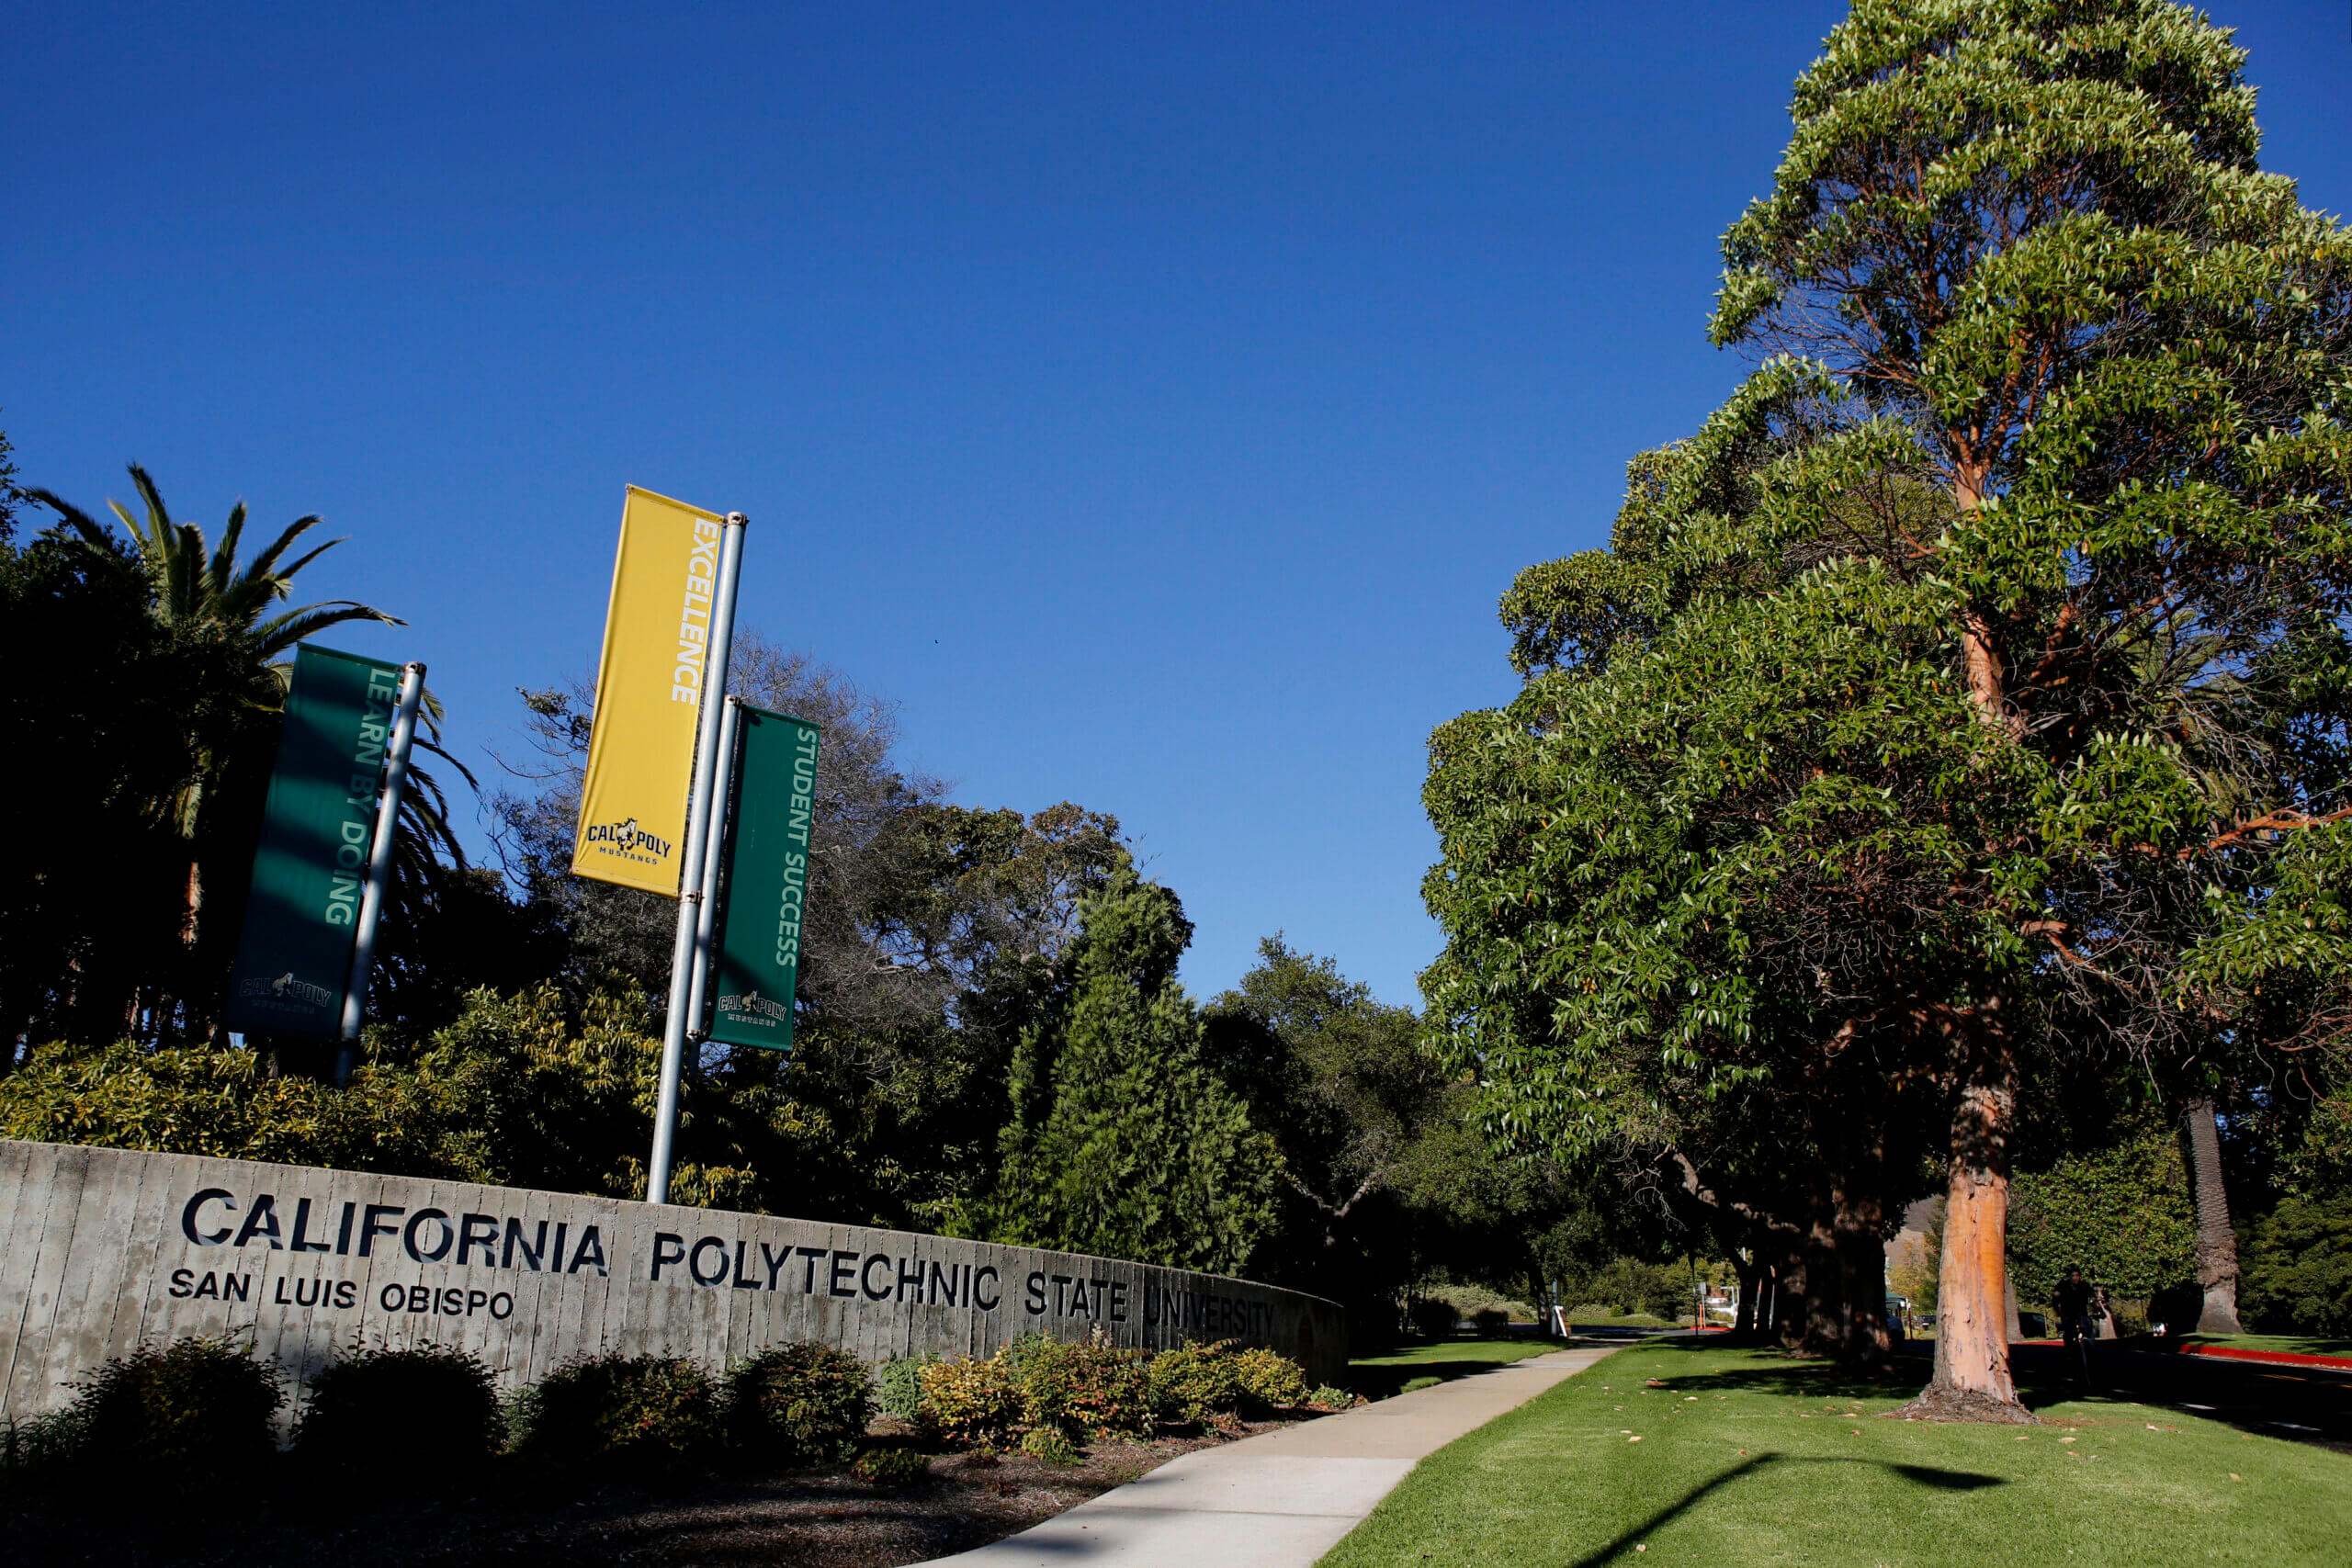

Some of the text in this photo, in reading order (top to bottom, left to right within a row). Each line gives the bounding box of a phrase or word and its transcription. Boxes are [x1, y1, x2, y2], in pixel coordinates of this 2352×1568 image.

[672, 517, 718, 705] EXCELLENCE
[324, 668, 398, 926] LEARN BY DOING
[588, 825, 671, 859] CAL POLY
[775, 727, 817, 967] STUDENT SUCCESS
[599, 846, 658, 865] MUSTANGS
[718, 995, 786, 1021] CAL POLY
[169, 1269, 514, 1321] SAN LUIS OBISPO
[182, 1188, 1274, 1338] CALIFORNIA POLYTECHNIC STATE UNIVERSITY
